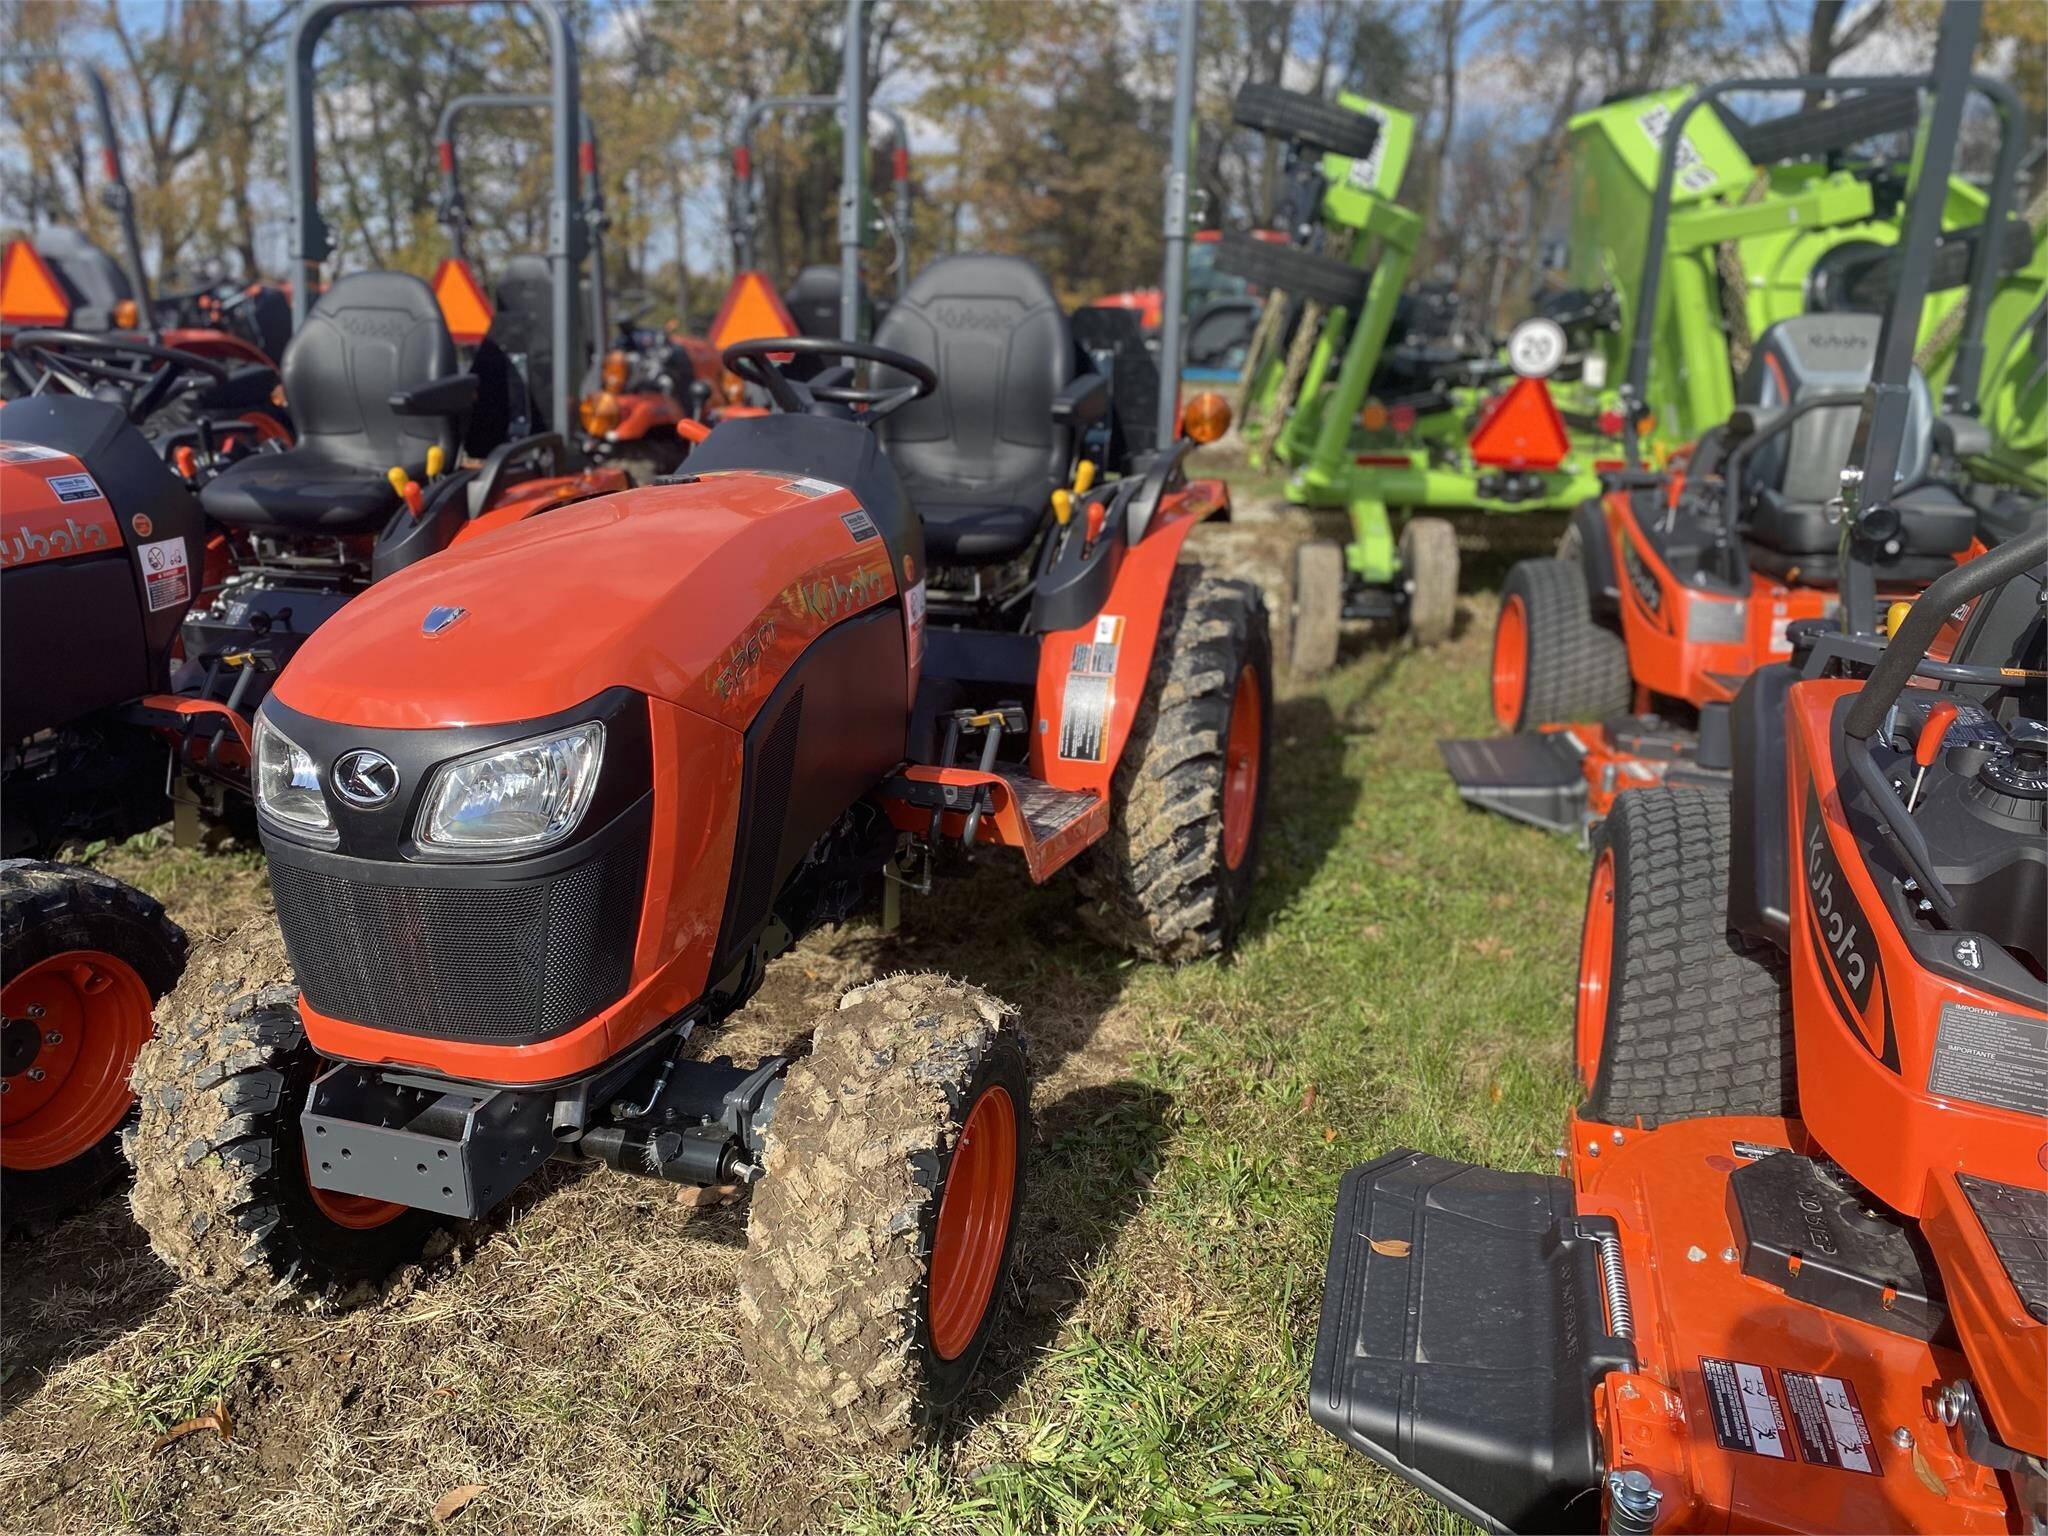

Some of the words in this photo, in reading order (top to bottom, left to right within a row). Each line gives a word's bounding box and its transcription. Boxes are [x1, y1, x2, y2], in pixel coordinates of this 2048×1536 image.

[0, 518, 108, 566] ubota
[803, 564, 885, 622] Kubota
[1809, 823, 1866, 991] Kubota
[1955, 1004, 1999, 1018] IMPORTANT
[1947, 1044, 1996, 1060] IMPORTANTE
[1771, 1400, 1786, 1431] DANGER
[1853, 1412, 1871, 1446] PELIGRO
